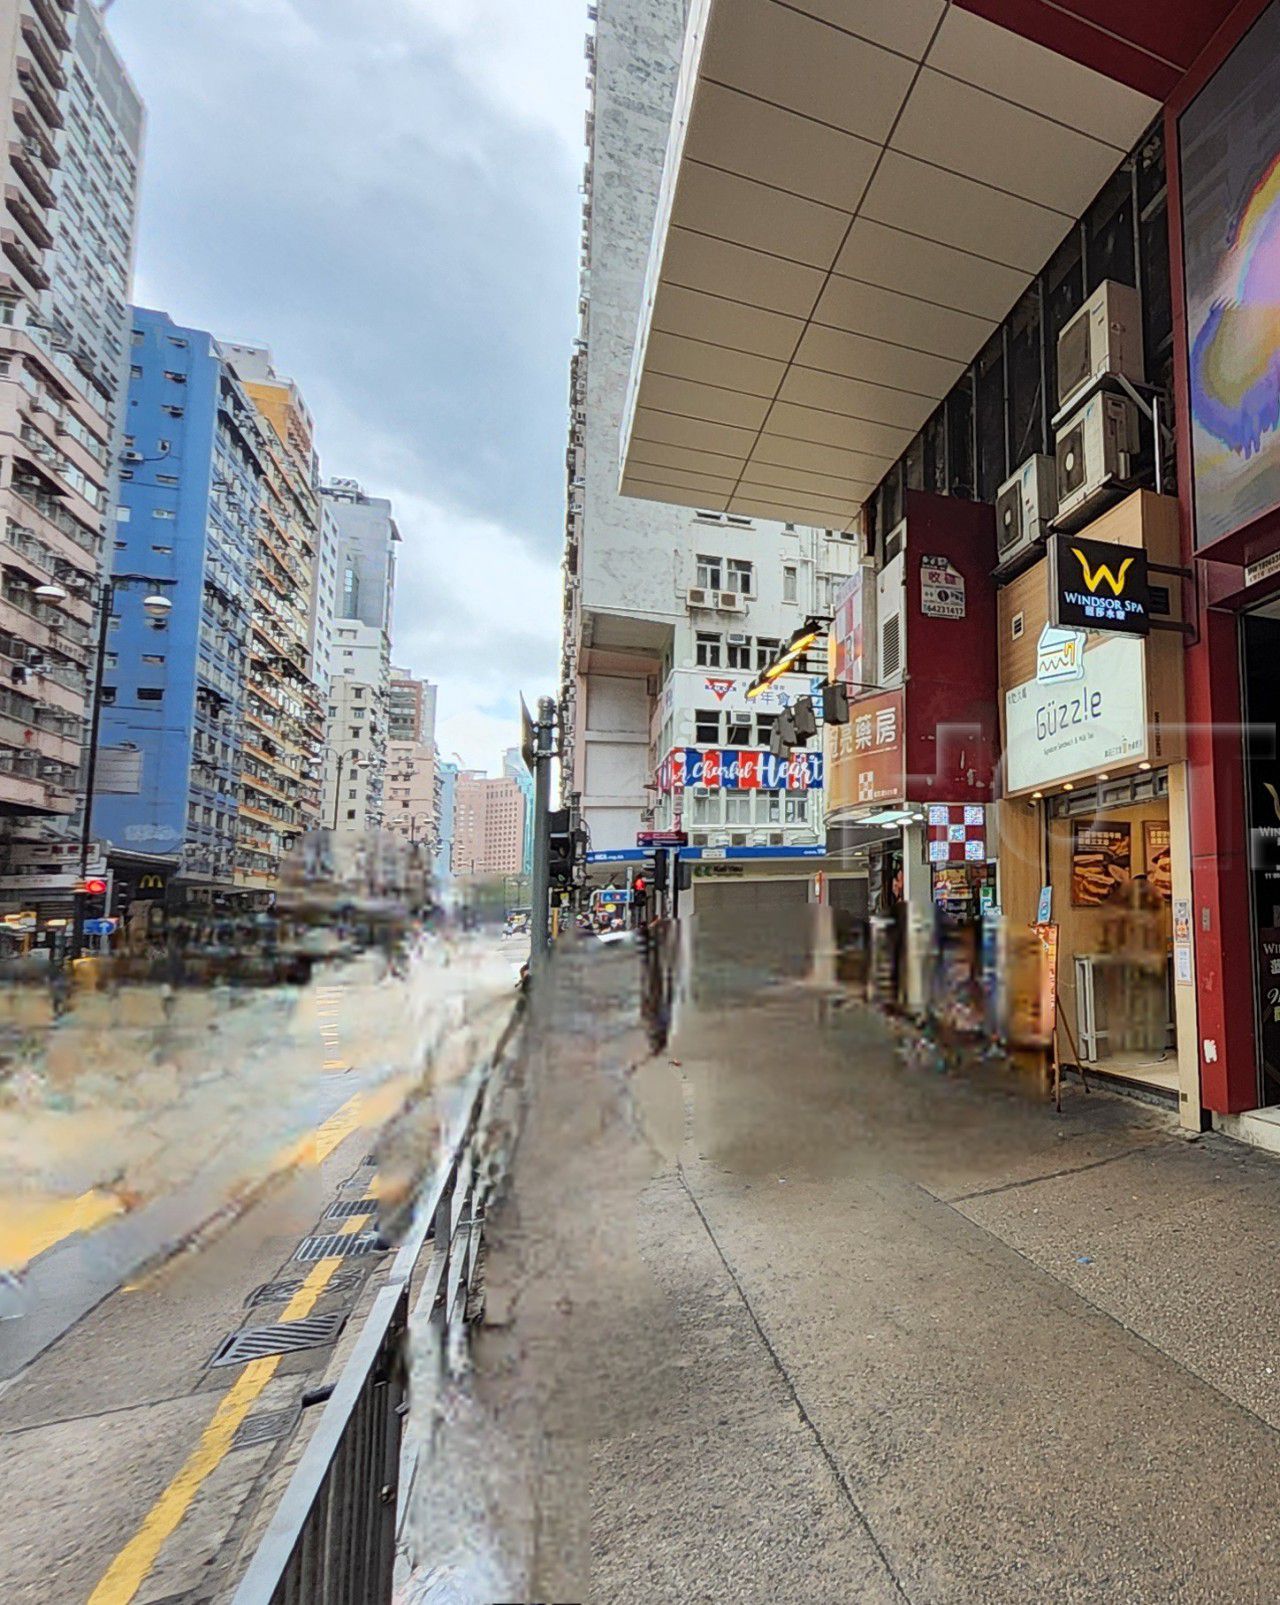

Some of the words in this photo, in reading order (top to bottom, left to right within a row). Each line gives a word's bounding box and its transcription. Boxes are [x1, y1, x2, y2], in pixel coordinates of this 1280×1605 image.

[1063, 591, 1122, 610] WINDSOR
[1124, 600, 1144, 614] SPA
[754, 752, 824, 787] Heart
